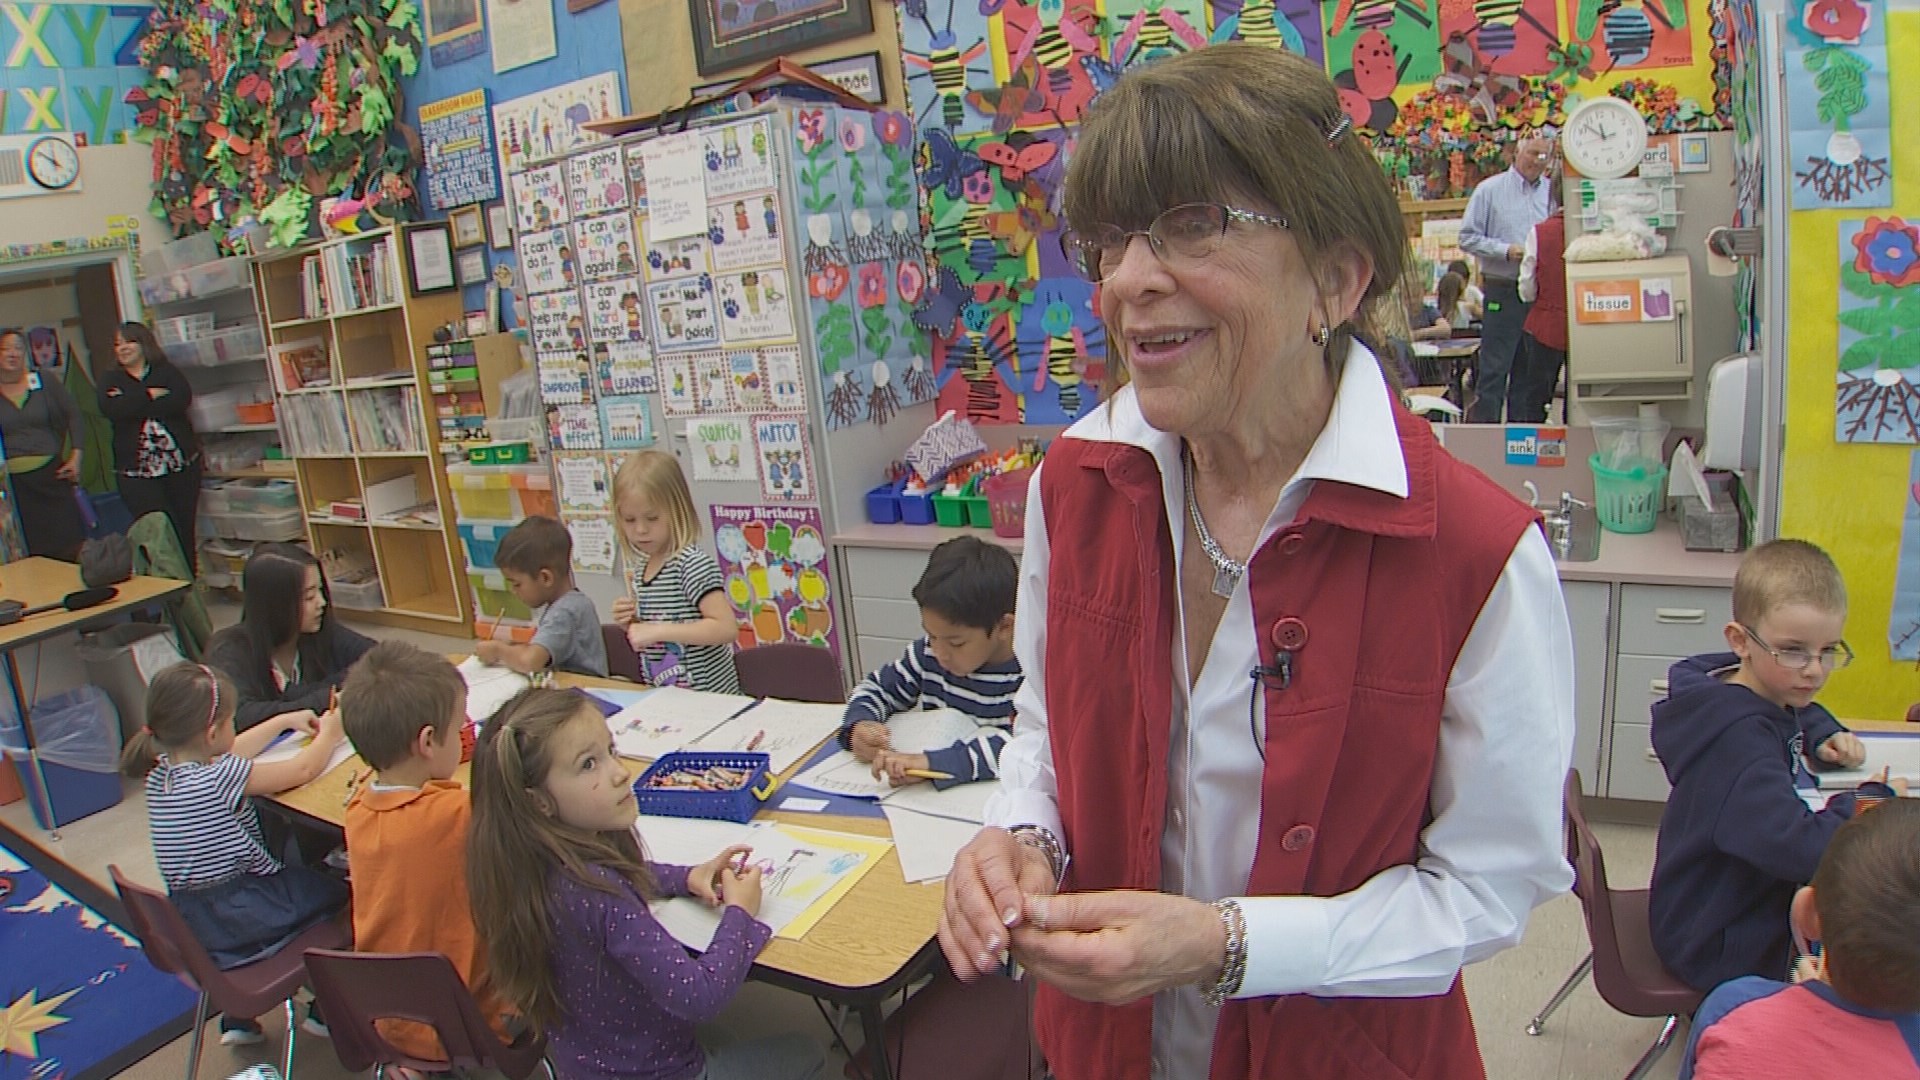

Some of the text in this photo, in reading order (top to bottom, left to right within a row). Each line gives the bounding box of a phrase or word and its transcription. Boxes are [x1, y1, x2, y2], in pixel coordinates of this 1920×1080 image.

[1, 3, 156, 67] X Y Z
[1644, 146, 1667, 161] ard
[589, 152, 617, 170] going
[589, 221, 608, 233] can
[526, 258, 540, 269] do
[597, 286, 617, 298] can
[597, 300, 611, 311] do
[1587, 294, 1629, 310] tissue
[1510, 440, 1533, 453] sink
[714, 506, 751, 522] Happy
[753, 506, 807, 523] Birthday
